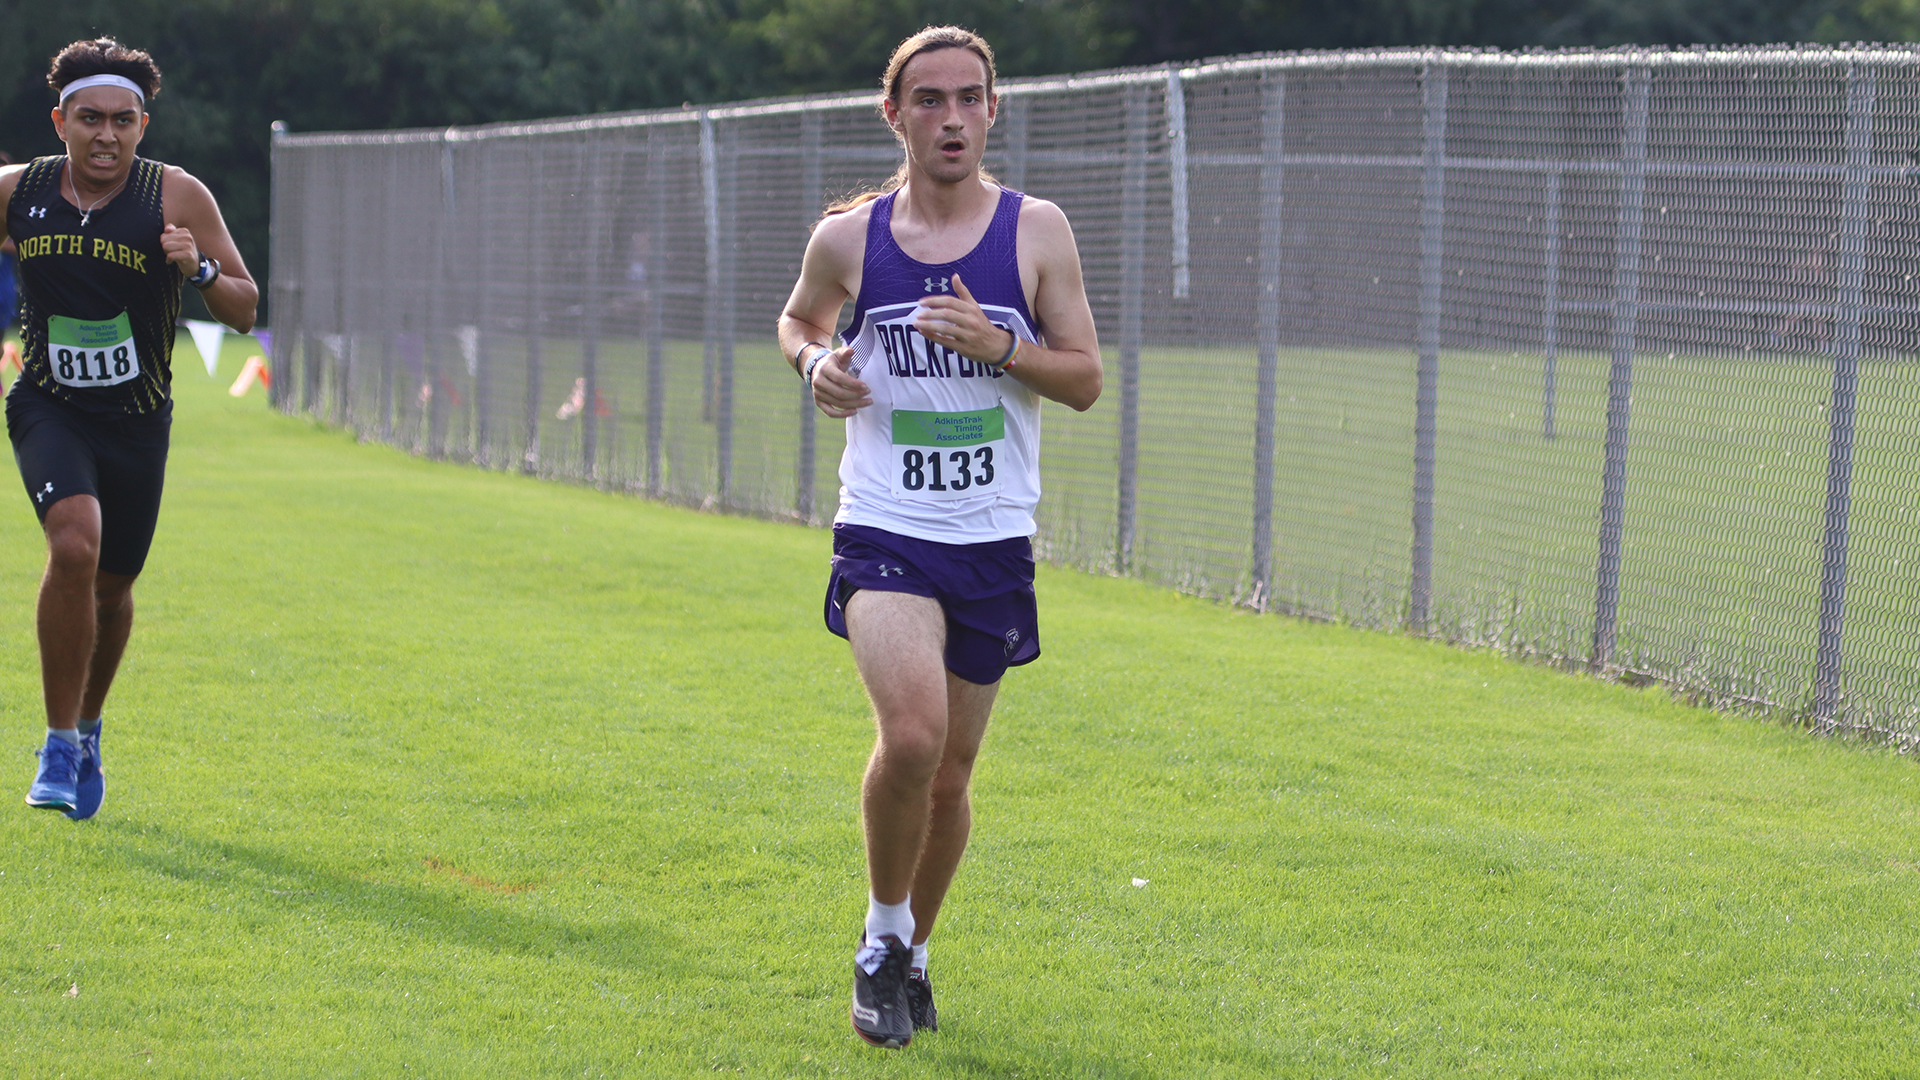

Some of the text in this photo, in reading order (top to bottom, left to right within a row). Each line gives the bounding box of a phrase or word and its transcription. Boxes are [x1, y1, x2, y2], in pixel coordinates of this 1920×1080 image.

[18, 234, 147, 274] NORTH PARK
[80, 336, 119, 344] Associates
[875, 324, 1008, 379] ROCKF
[57, 346, 131, 381] 8118
[934, 416, 983, 425] AdkinsTrak
[954, 424, 983, 433] Timing
[936, 432, 984, 441] Associates
[902, 446, 995, 491] 8133
